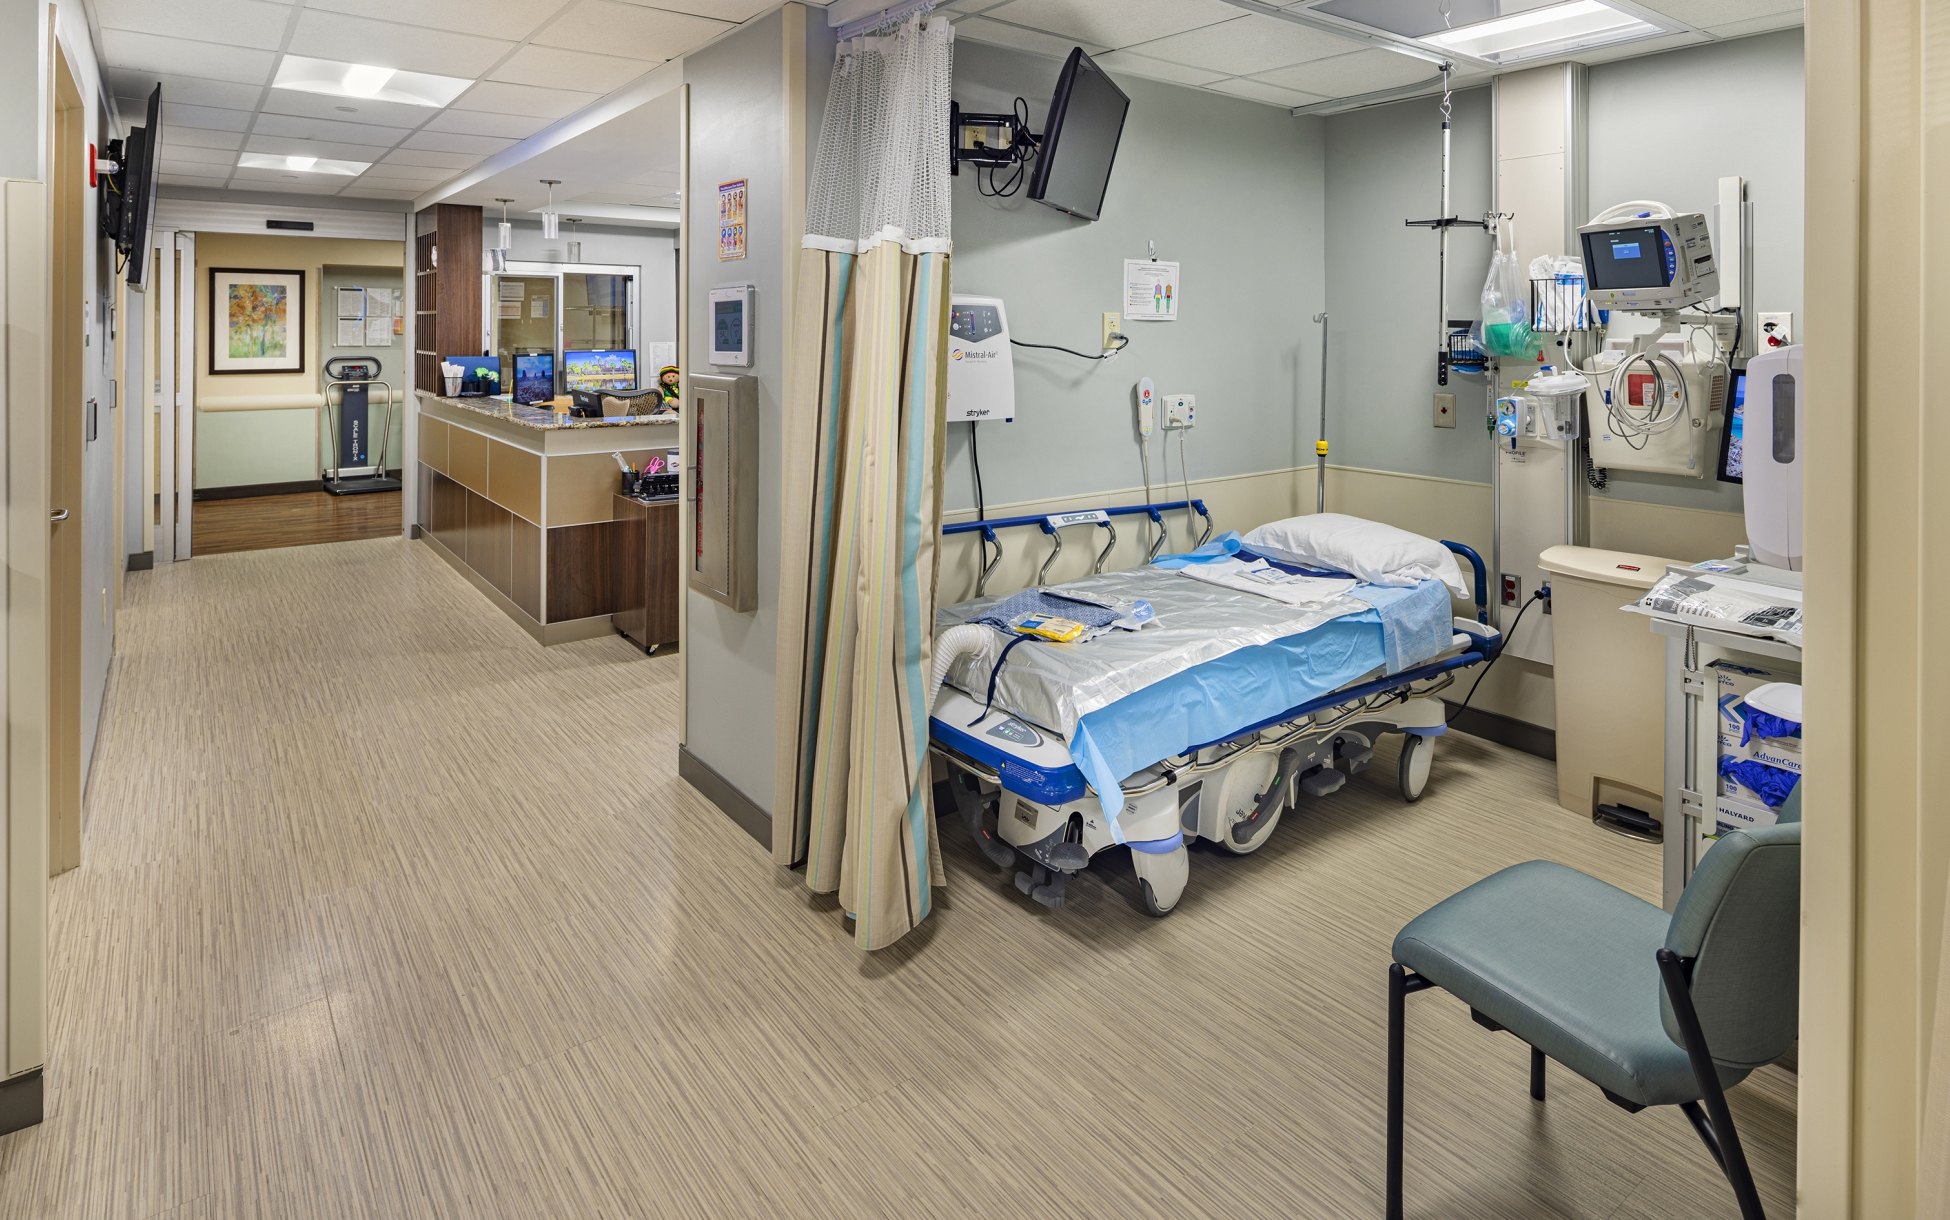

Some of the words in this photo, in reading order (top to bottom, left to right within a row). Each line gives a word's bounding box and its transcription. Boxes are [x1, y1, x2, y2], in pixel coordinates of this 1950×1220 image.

[966, 409, 990, 417] stryker
[1728, 723, 1740, 731] 100
[1719, 807, 1755, 823] HALYARD
